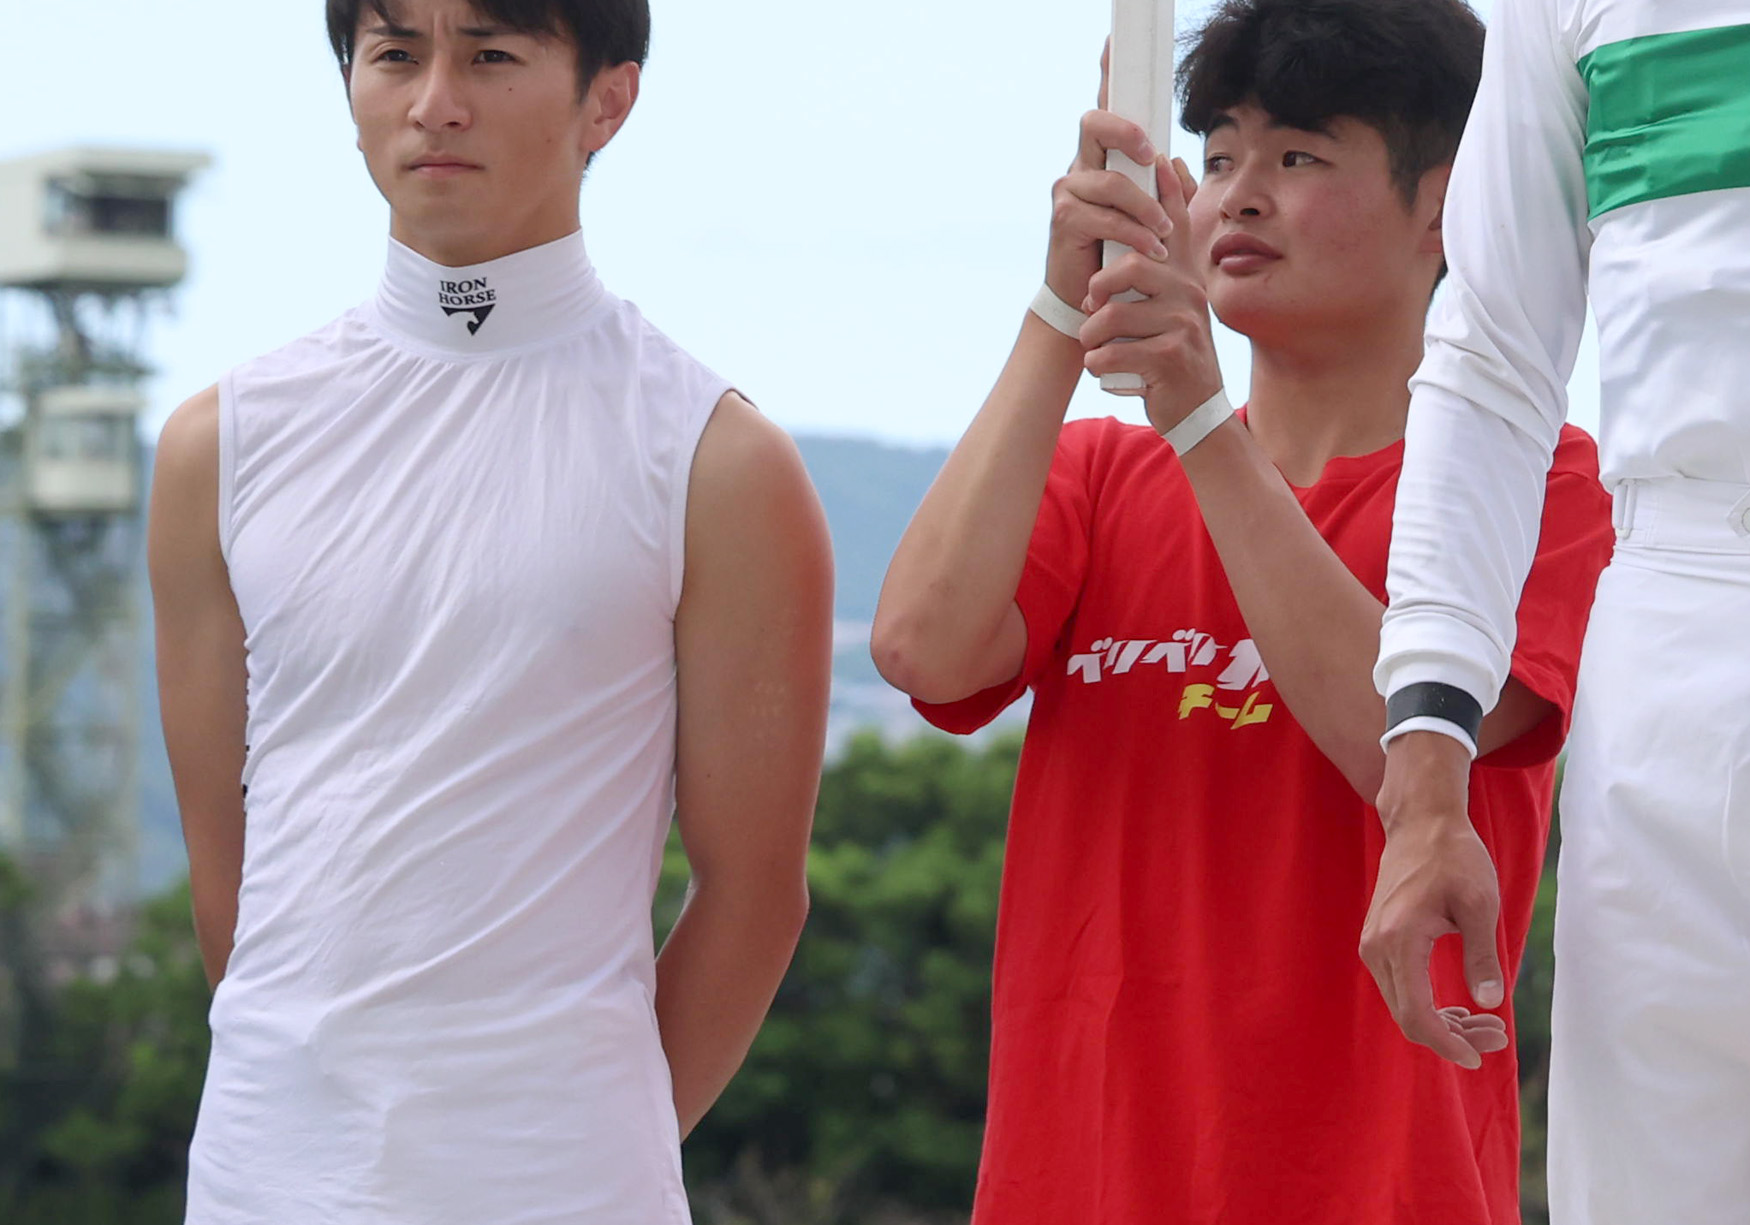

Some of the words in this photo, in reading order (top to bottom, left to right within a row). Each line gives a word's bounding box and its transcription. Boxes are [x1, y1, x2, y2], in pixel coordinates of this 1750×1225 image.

[439, 276, 487, 294] IRON
[438, 289, 497, 306] HORSE
[1178, 684, 1273, 730] チーム
